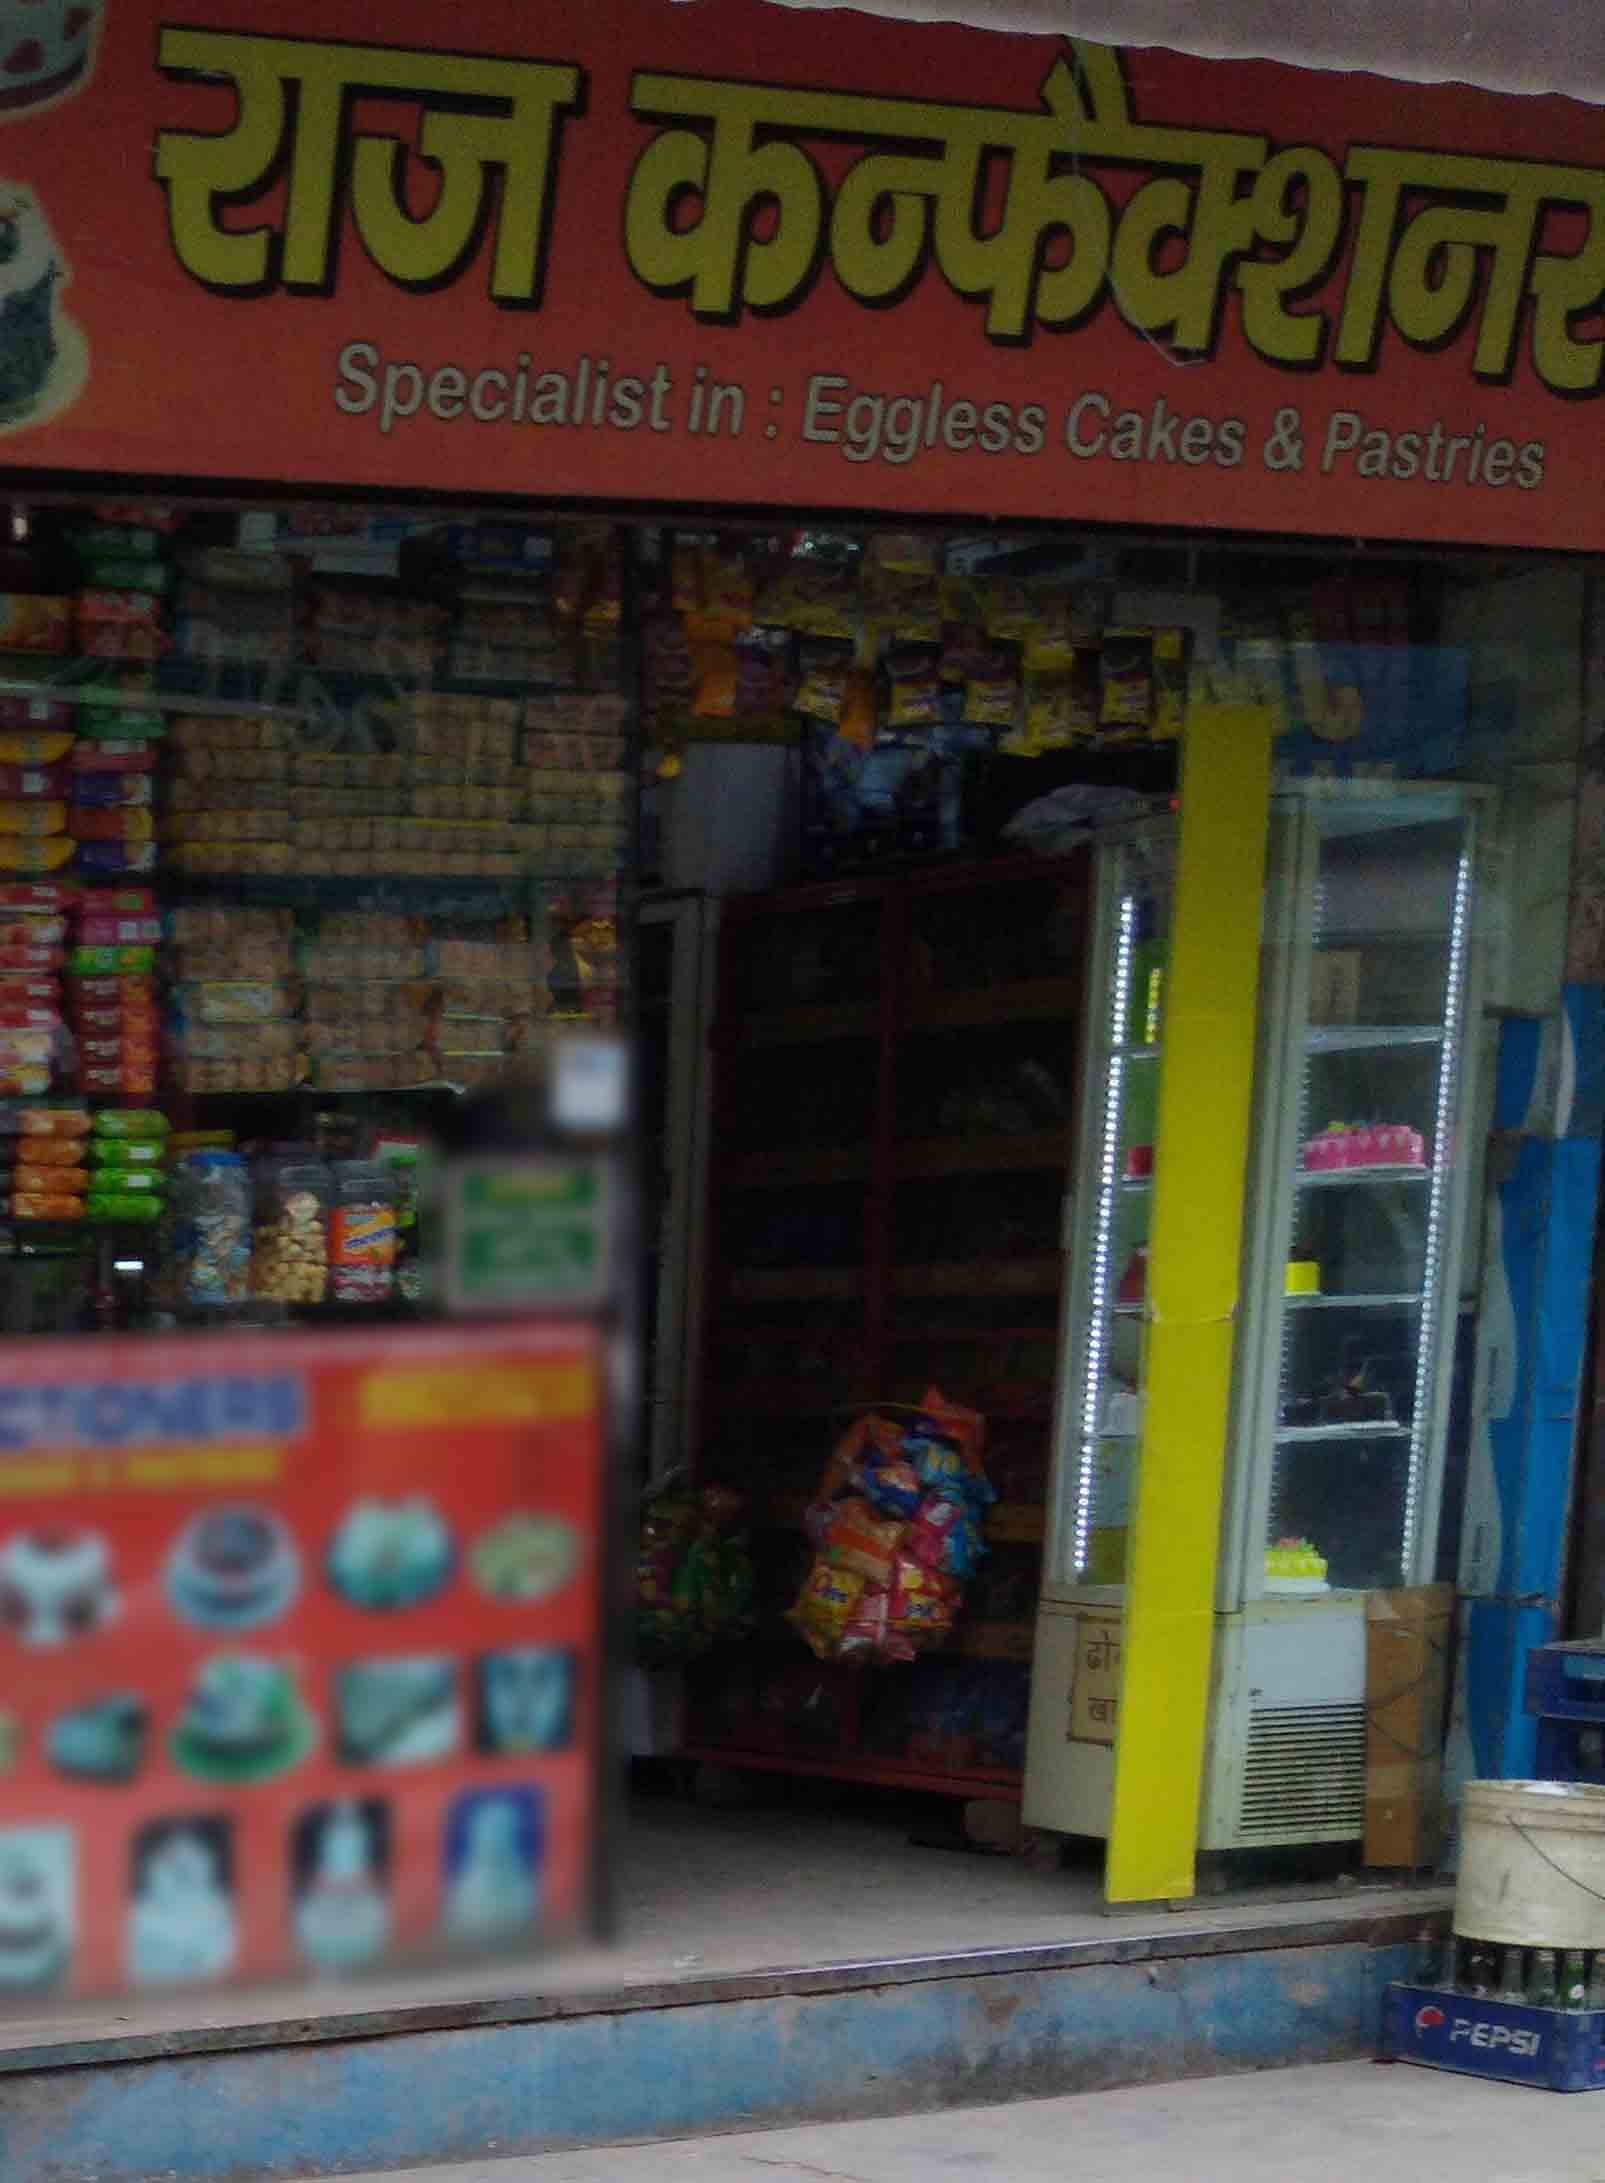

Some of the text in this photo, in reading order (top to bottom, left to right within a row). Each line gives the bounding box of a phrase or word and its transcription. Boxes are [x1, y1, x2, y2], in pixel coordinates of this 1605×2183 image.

[154, 26, 587, 309] राज
[334, 341, 671, 433] Specialist
[687, 366, 745, 434] in
[801, 375, 1046, 463] Eggless
[1065, 391, 1246, 467] Cakes
[1263, 407, 1304, 471] &
[1321, 411, 1545, 489] Pastries
[1449, 2018, 1541, 2056] PEPSI
